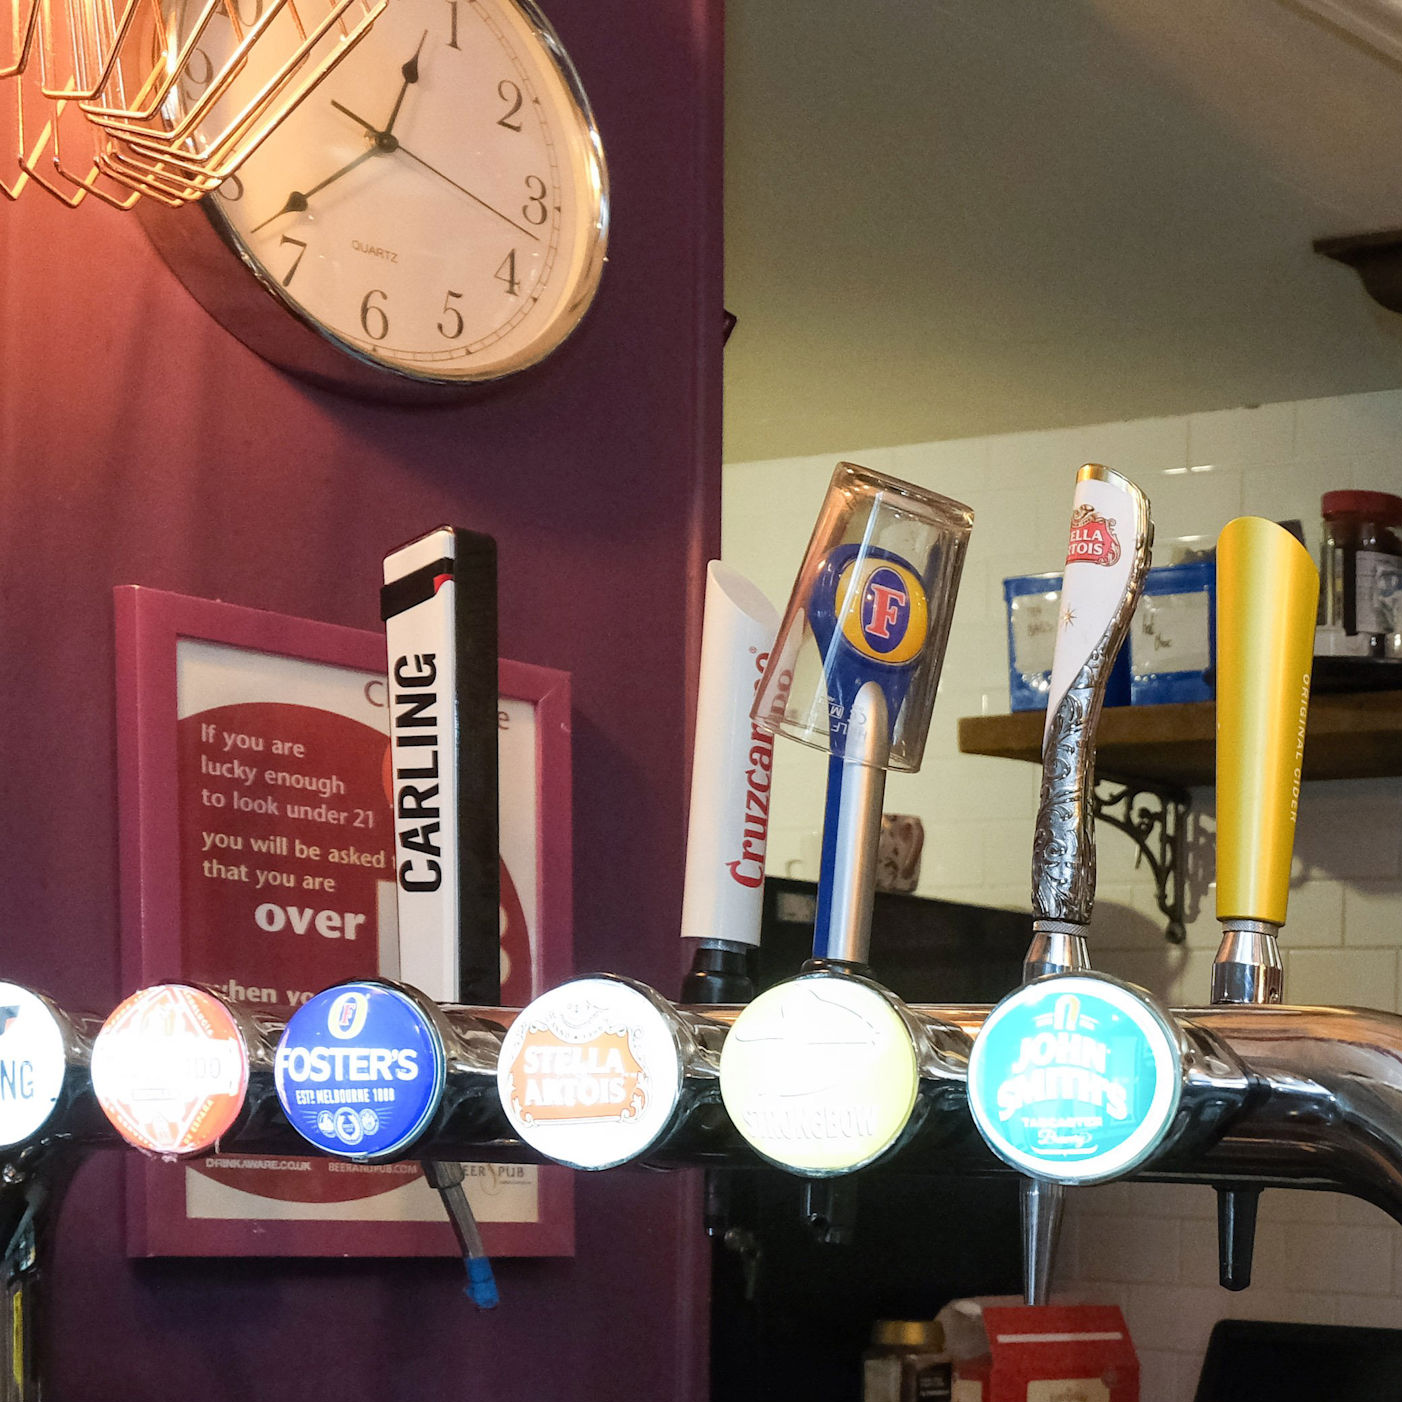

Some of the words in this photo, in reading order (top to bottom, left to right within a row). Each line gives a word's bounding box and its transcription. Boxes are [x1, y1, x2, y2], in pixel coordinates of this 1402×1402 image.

[497, 80, 524, 132] 2
[521, 175, 548, 226] 3
[279, 236, 308, 287] 7
[351, 239, 399, 264] QUARTZ
[494, 248, 521, 295] 4
[360, 288, 389, 341] 6
[437, 290, 465, 339] 5
[864, 583, 906, 639] F
[1294, 673, 1310, 760] ORIGINAL
[201, 722, 216, 742] If
[222, 728, 264, 752] you
[271, 738, 305, 758] are
[201, 755, 256, 782] lucky
[264, 766, 345, 798] enough
[394, 652, 443, 894] CARLING
[1290, 767, 1301, 822] CIDER
[202, 787, 226, 807] to
[233, 791, 279, 816] look
[286, 804, 348, 825] under
[353, 809, 375, 829] 21
[202, 830, 242, 852] you
[250, 836, 289, 857] will
[294, 839, 321, 860] be
[327, 845, 386, 869] asked
[202, 858, 249, 882] that
[255, 868, 296, 892] you
[302, 872, 336, 893] are
[254, 902, 367, 941] over
[275, 1046, 419, 1083] FOSTER'S
[523, 1044, 626, 1075] STELLA
[1012, 1031, 1107, 1074] JOHN
[316, 1088, 370, 1104] MELBOURNE
[524, 1076, 627, 1107] ARTOIS
[997, 1065, 1128, 1122] SMITH'S
[205, 1157, 312, 1172] DRINKAWARE.CO.UK
[497, 1166, 526, 1179] PUB
